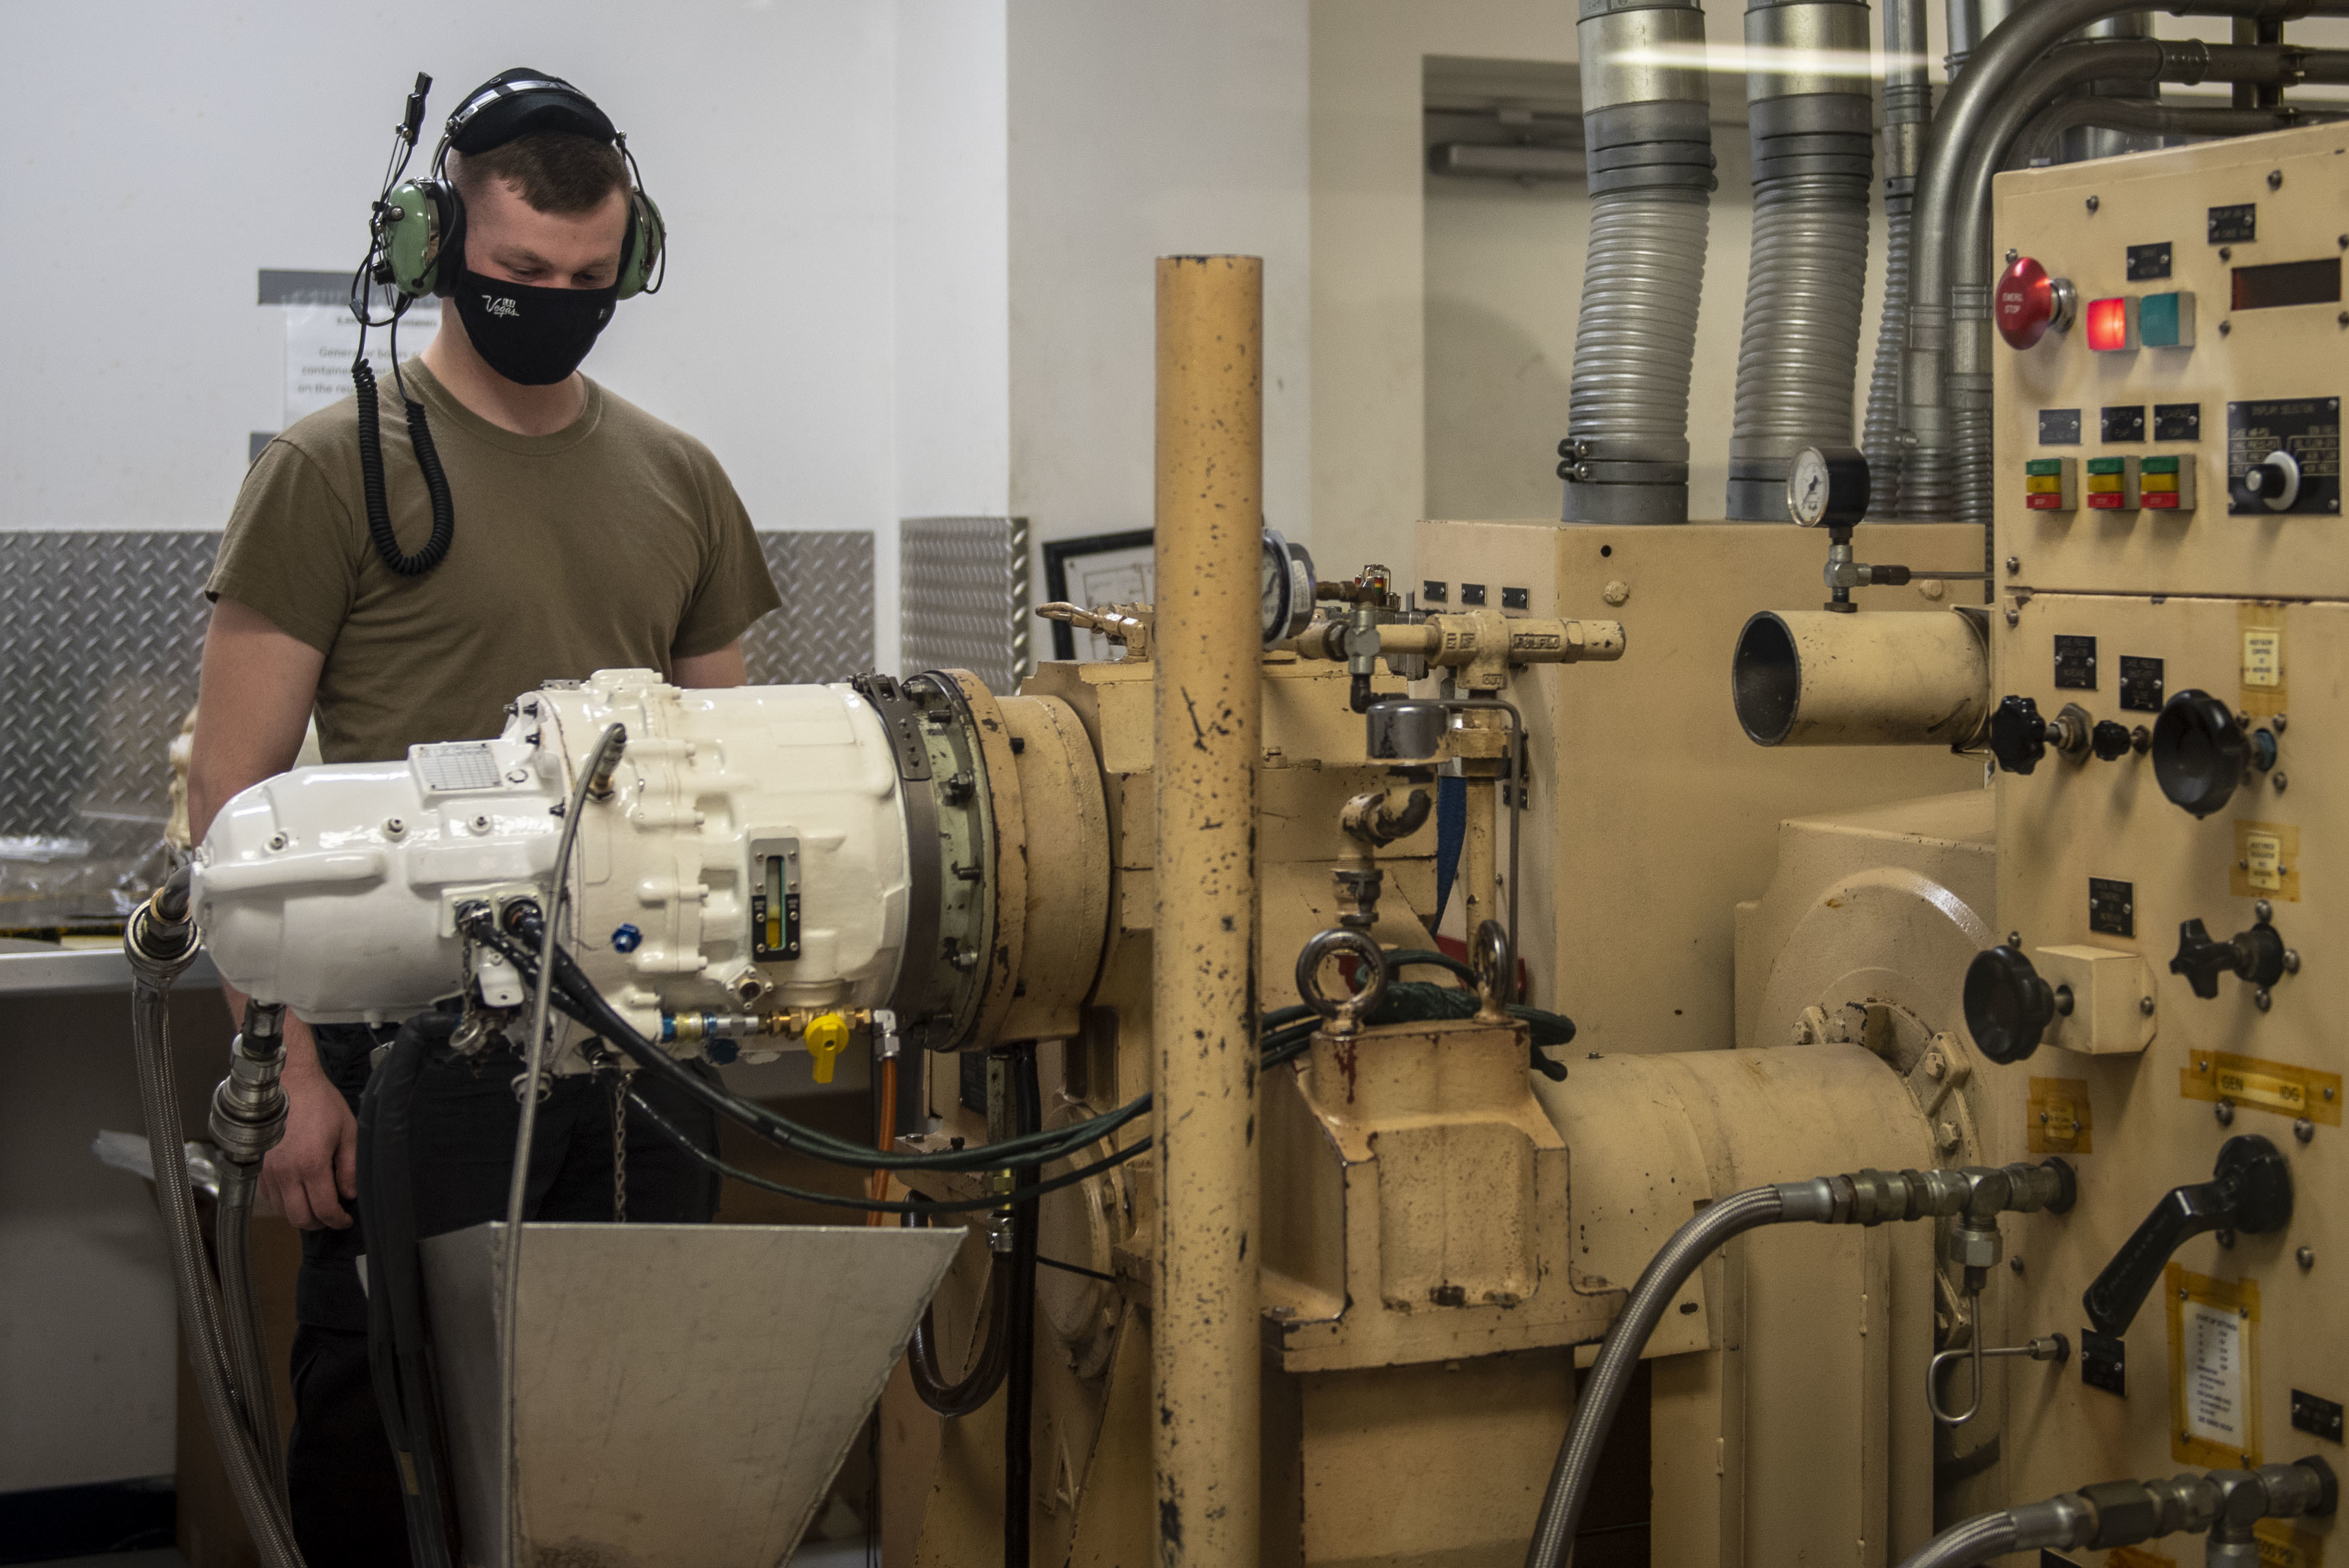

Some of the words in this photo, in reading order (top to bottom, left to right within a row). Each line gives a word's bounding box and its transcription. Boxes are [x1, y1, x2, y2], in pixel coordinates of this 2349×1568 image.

[482, 295, 520, 318] Vegas
[2004, 304, 2021, 314] STOP
[319, 346, 374, 358] Generaor
[2221, 1075, 2244, 1091] GEN
